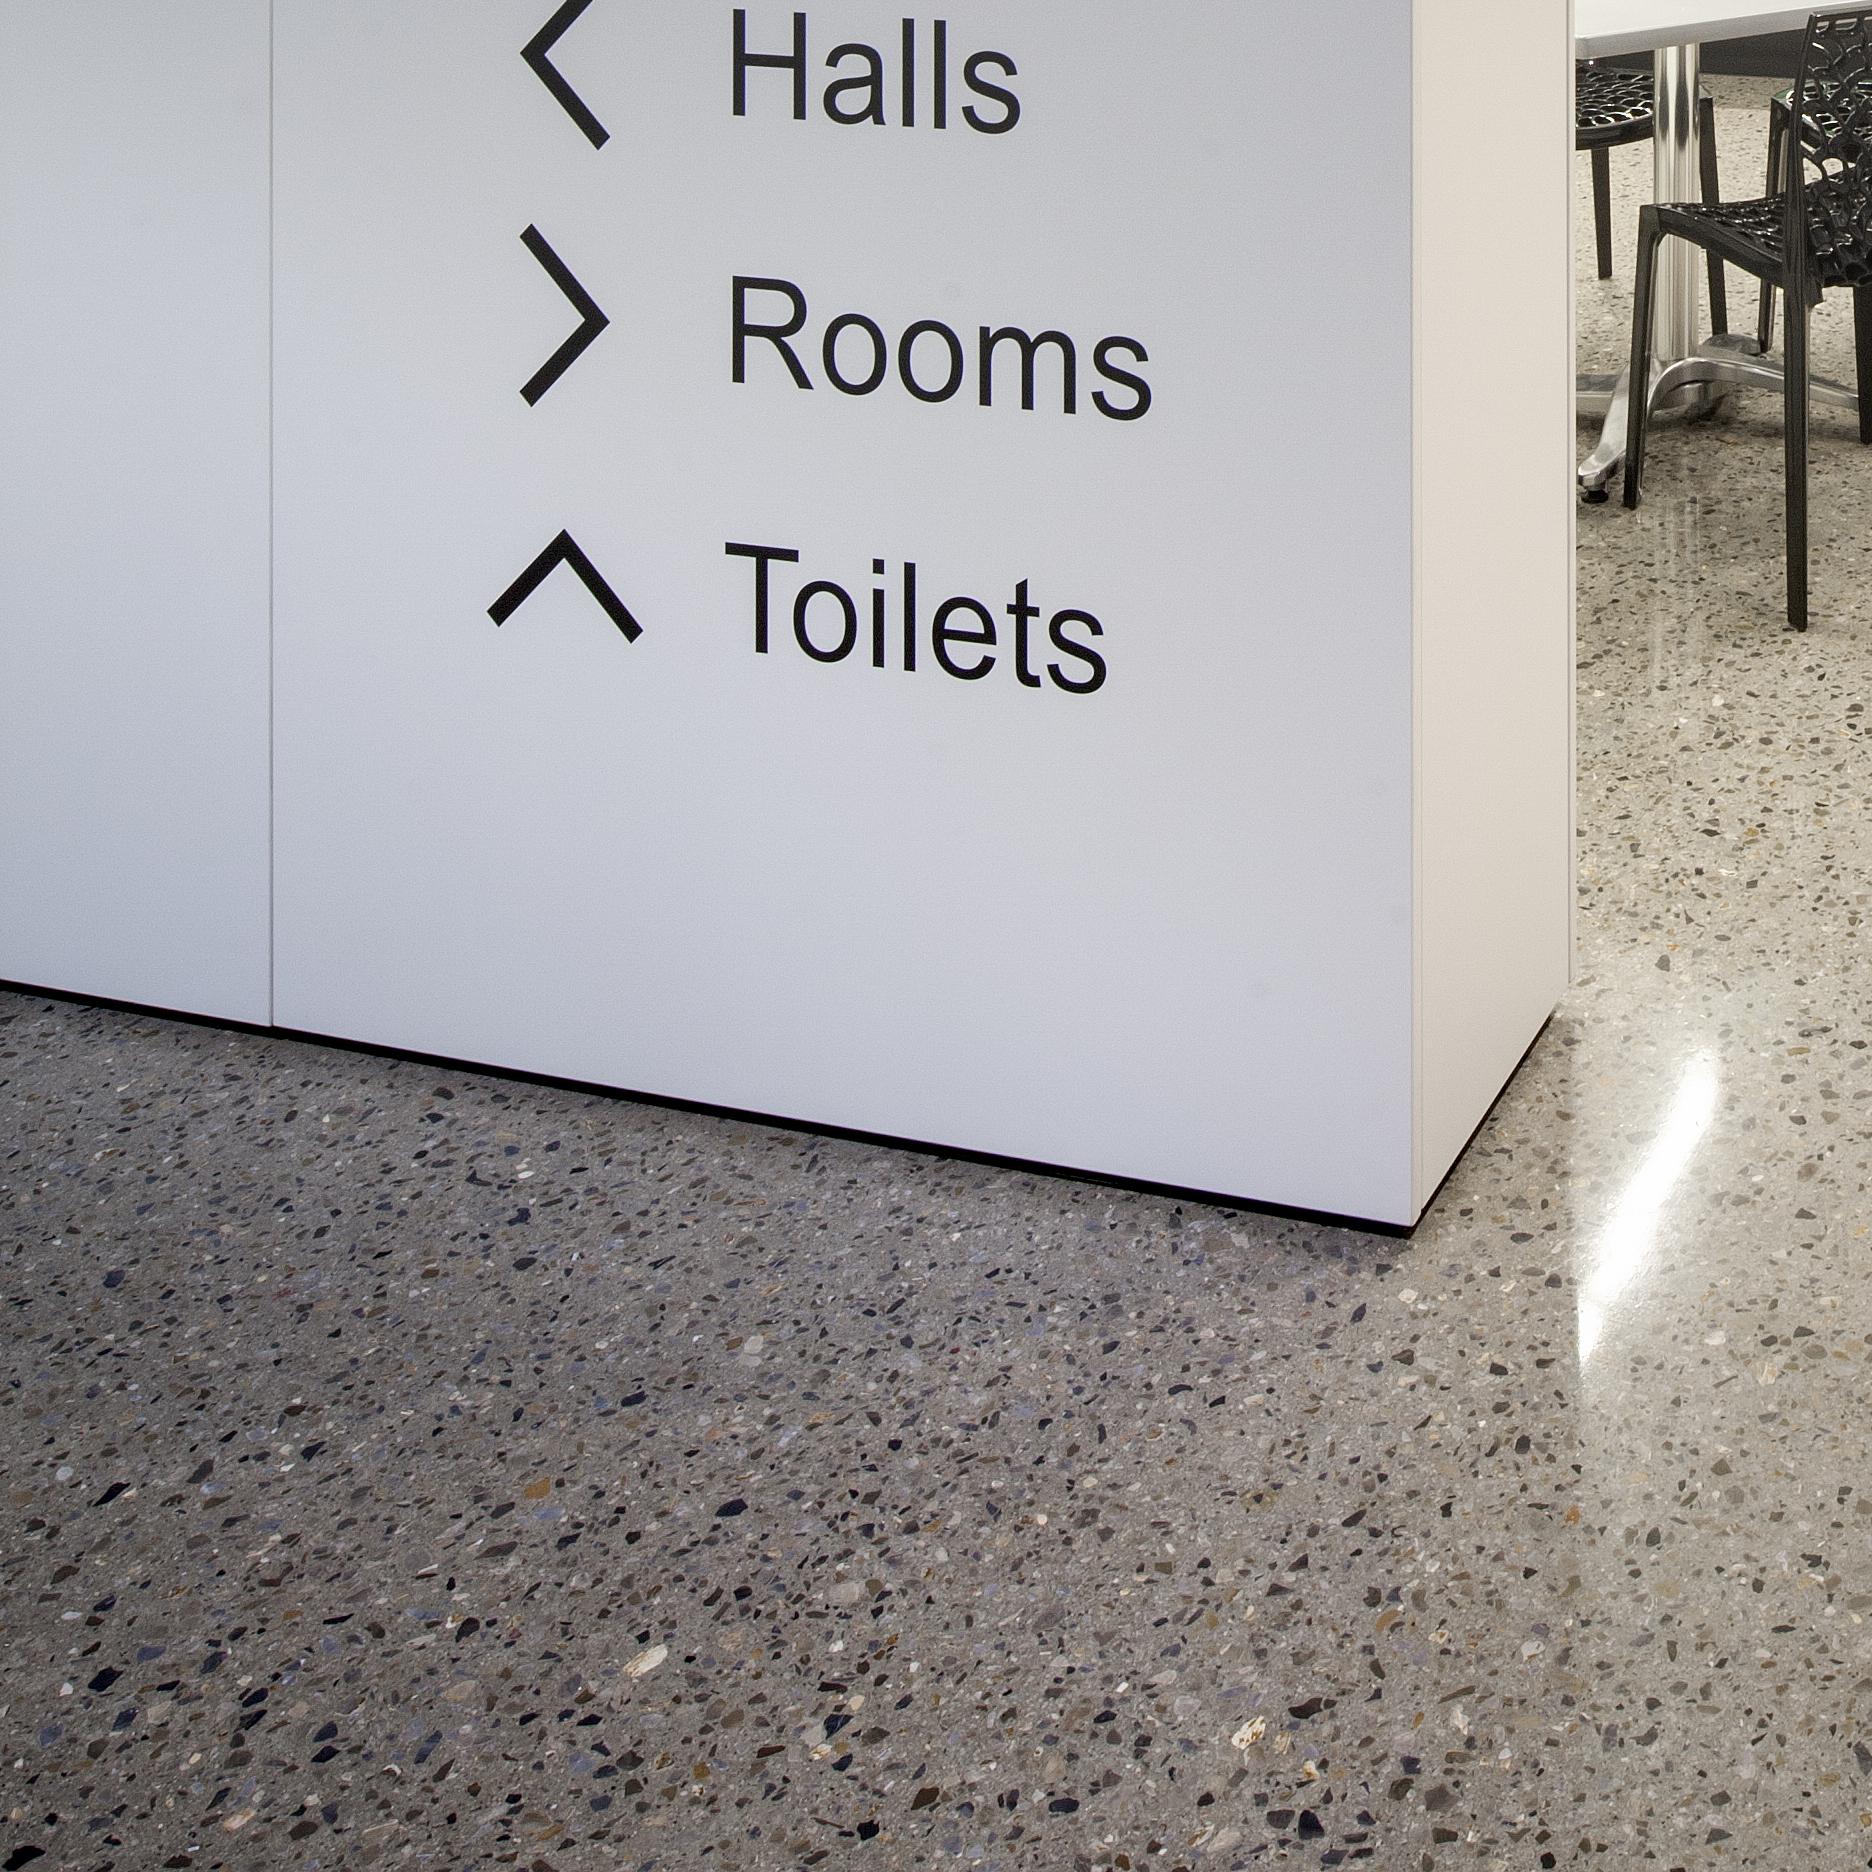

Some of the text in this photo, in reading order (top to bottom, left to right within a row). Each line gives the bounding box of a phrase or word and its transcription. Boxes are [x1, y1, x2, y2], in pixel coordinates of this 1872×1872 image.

[731, 8, 1022, 135] Halls
[731, 275, 1153, 422] Rooms
[724, 542, 1108, 695] Toilets
